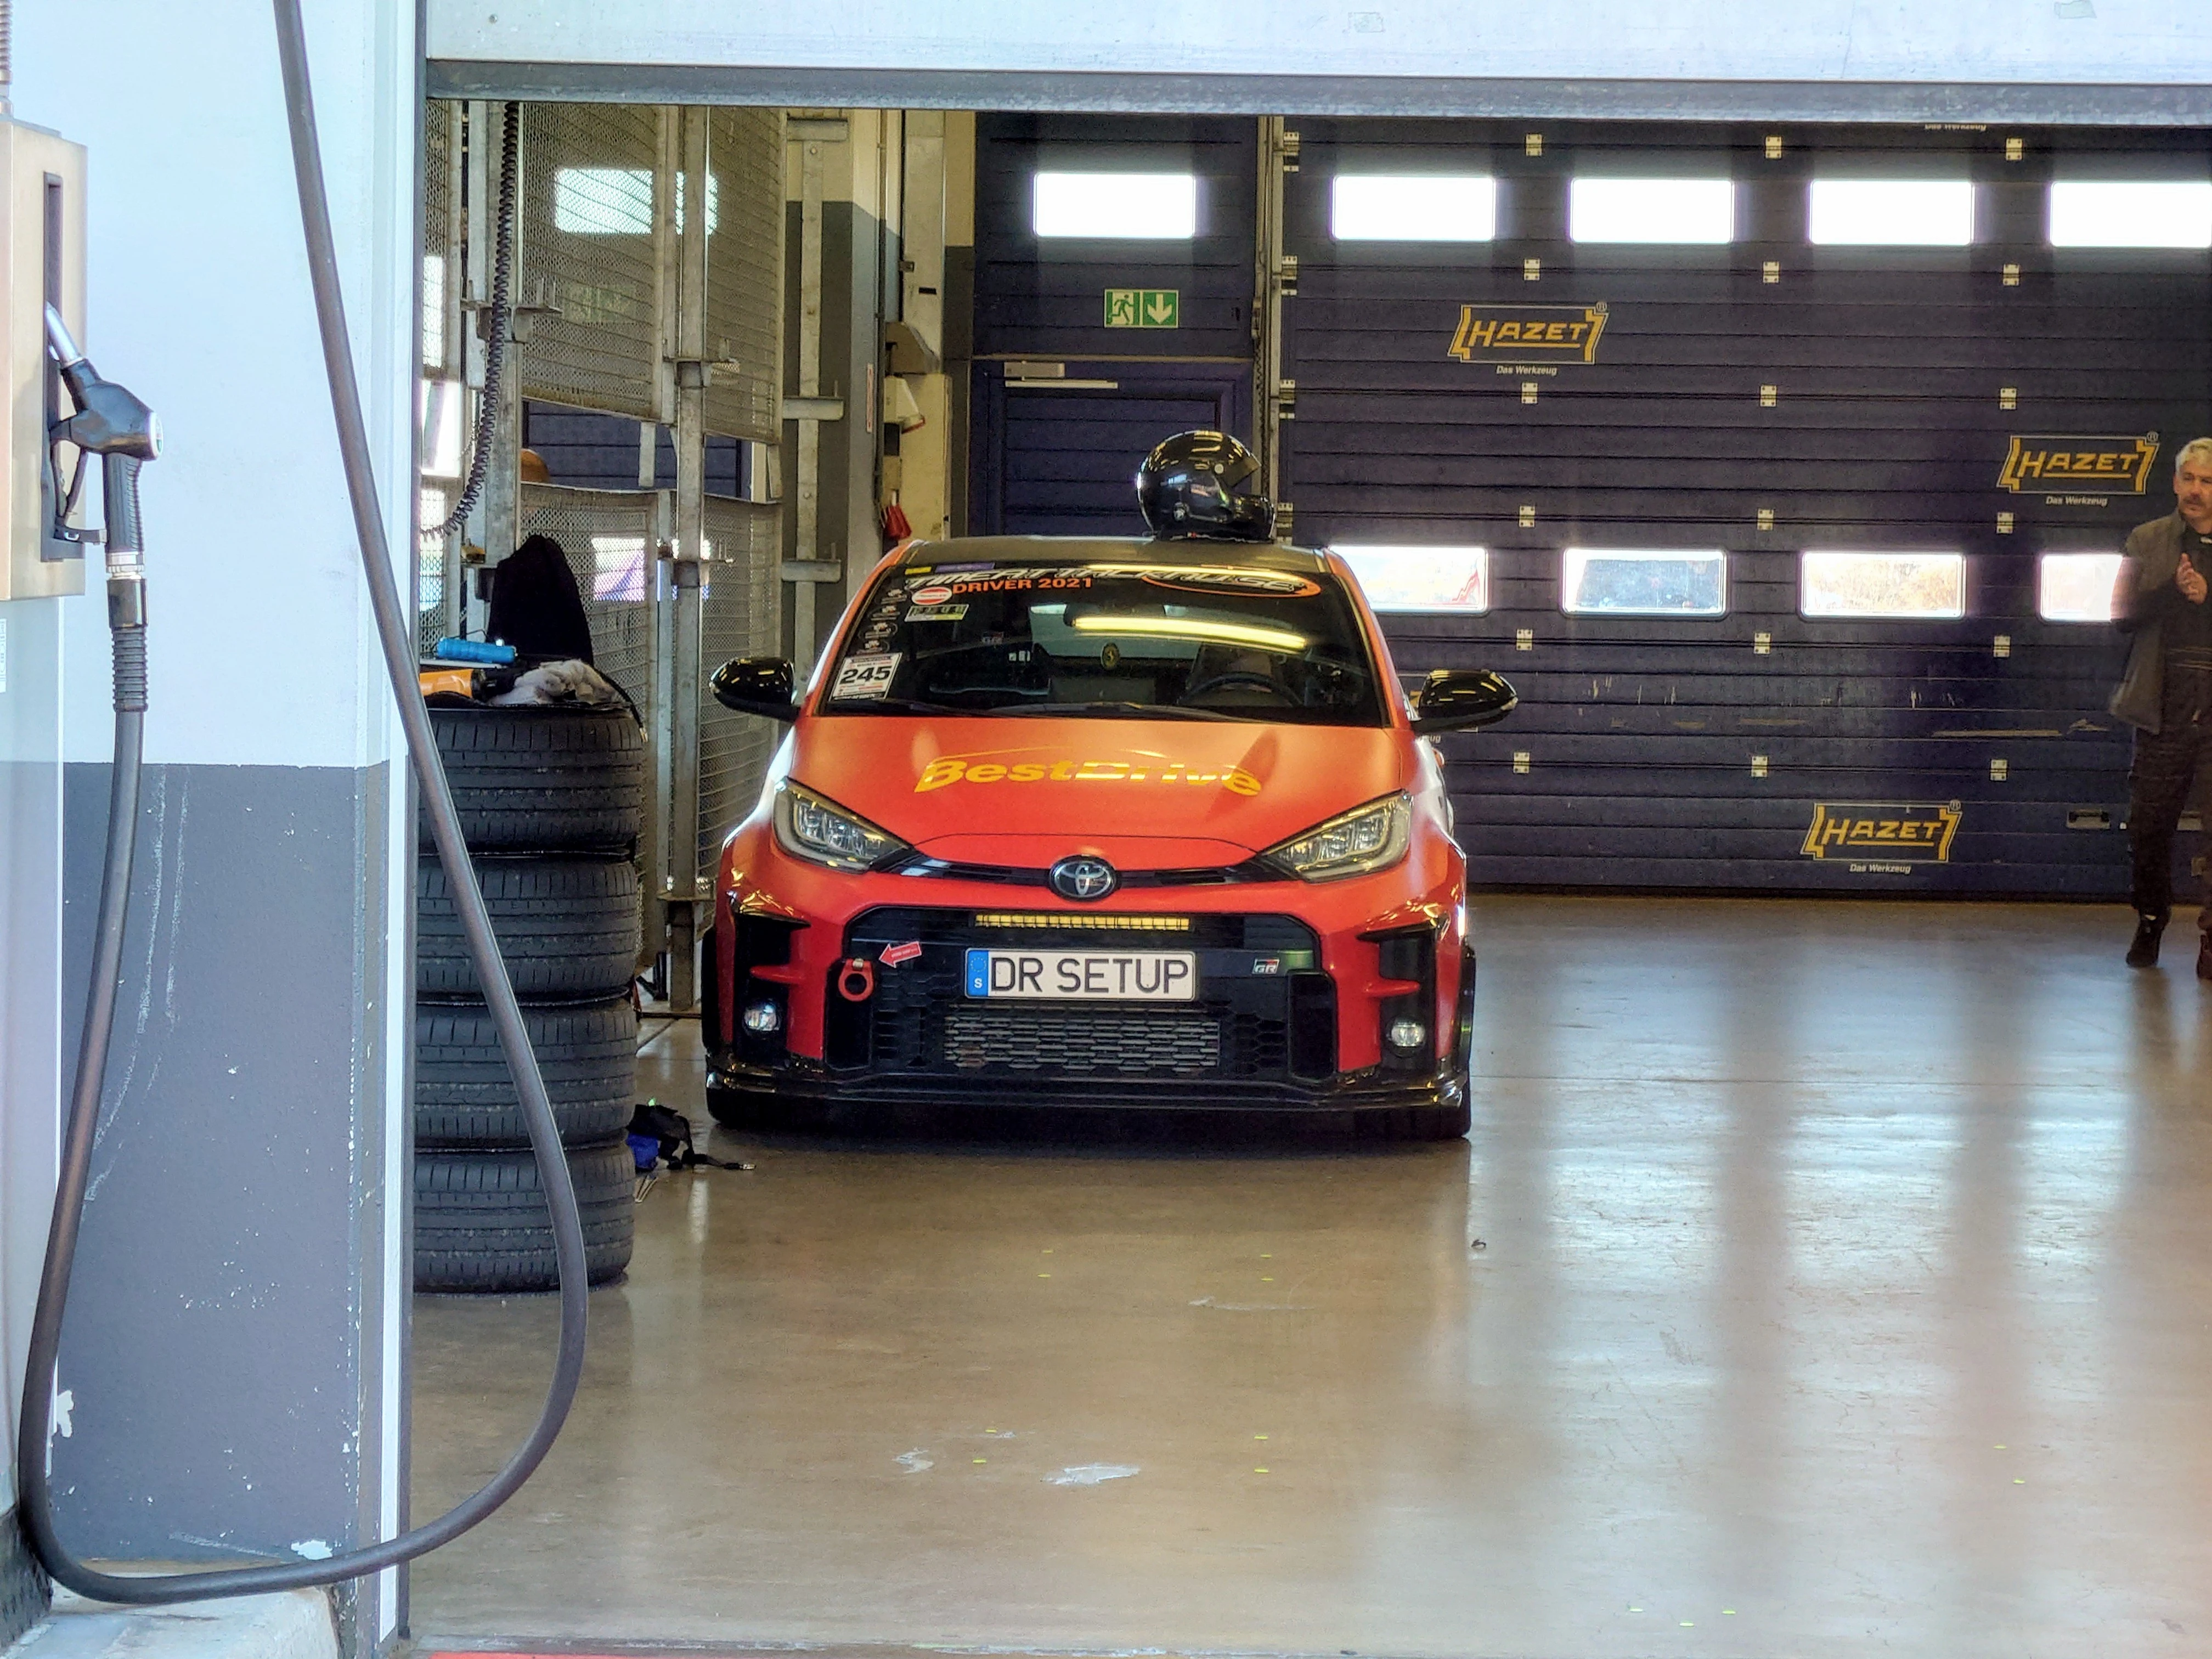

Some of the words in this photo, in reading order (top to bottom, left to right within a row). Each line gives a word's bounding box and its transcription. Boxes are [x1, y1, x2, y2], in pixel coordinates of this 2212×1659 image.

[1468, 320, 1588, 347] HAZET
[1496, 365, 1514, 374] Das
[1515, 366, 1558, 375] Werkzeug
[2017, 451, 2138, 478] HAZET
[2045, 496, 2063, 505] Das
[2066, 496, 2108, 506] Werkzeug
[952, 579, 1032, 594] DRIVER
[1038, 578, 1092, 588] 2021
[839, 665, 892, 684] 245
[914, 760, 1261, 796] BestDrive
[1822, 819, 1942, 845] HAZET
[1849, 864, 1866, 872] Das
[1869, 864, 1912, 874] Werkzeug
[974, 978, 983, 989] S
[990, 957, 1042, 992] DR
[1057, 958, 1188, 994] SETUP
